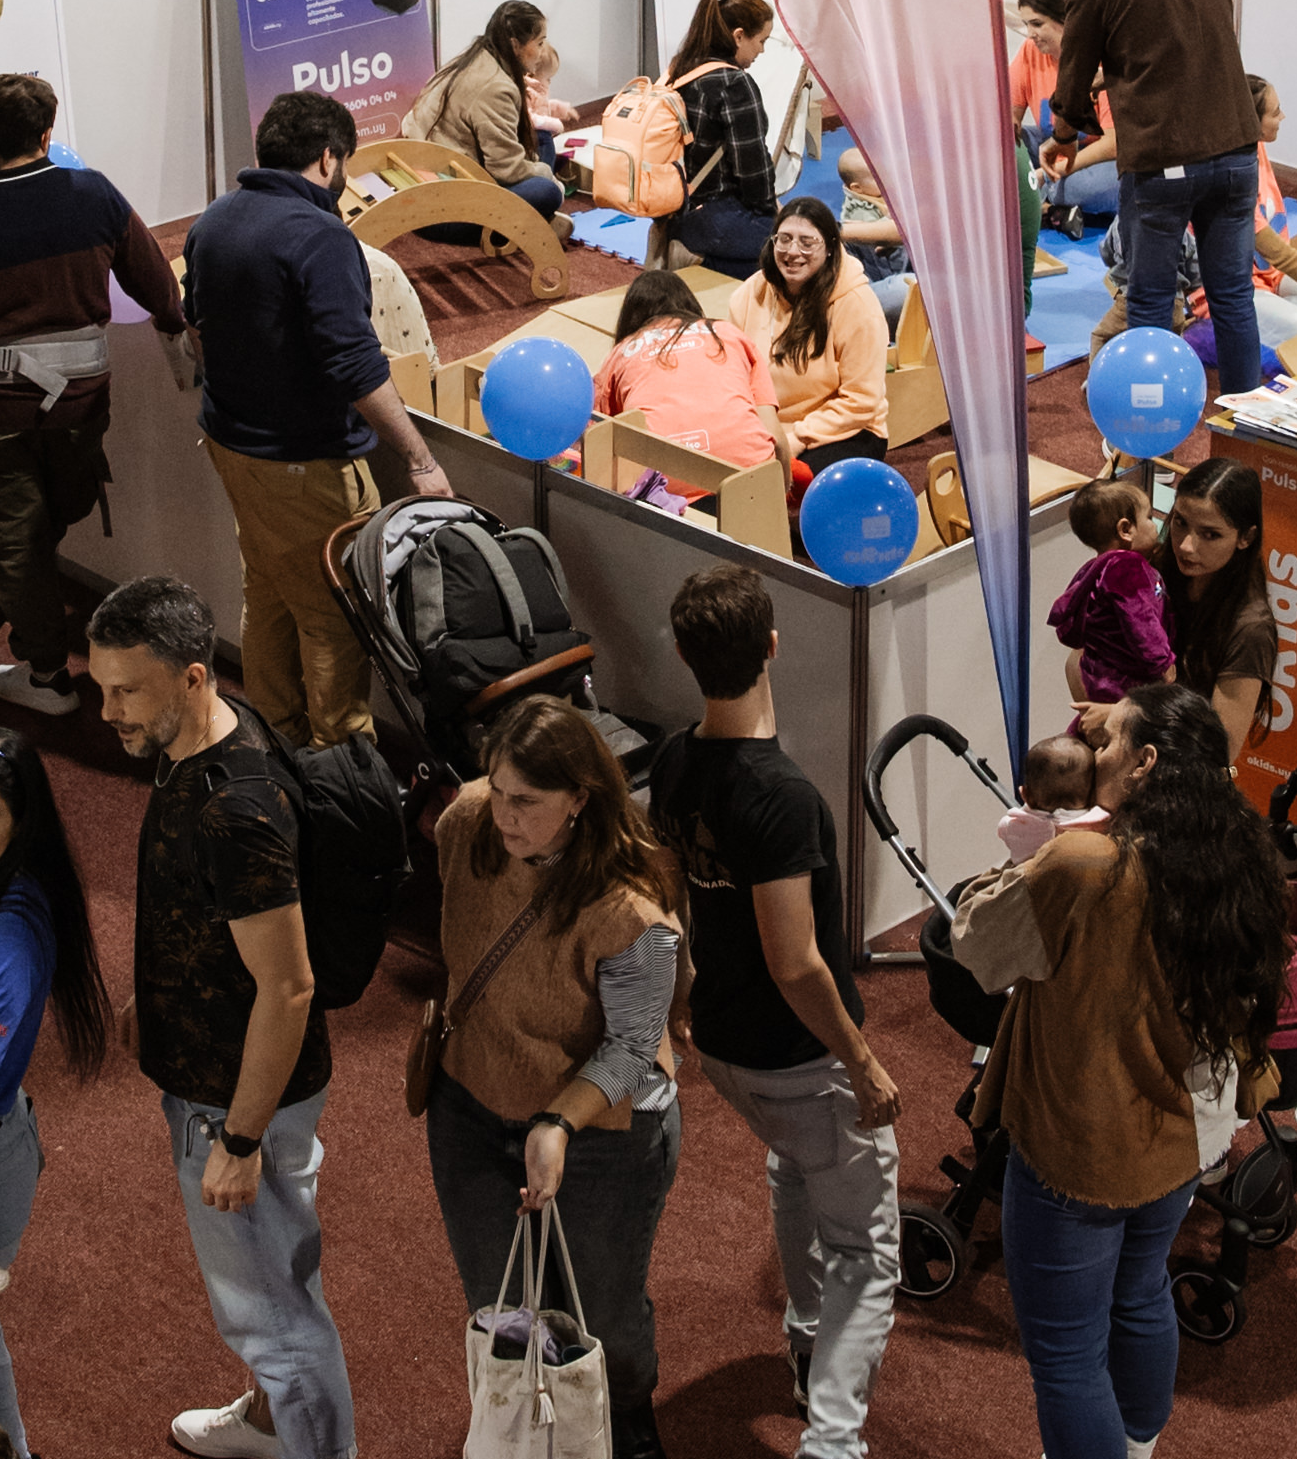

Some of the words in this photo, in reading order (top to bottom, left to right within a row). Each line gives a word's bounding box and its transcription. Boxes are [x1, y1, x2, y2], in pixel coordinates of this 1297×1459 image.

[293, 50, 393, 93] Pulso
[369, 94, 382, 106] 04
[384, 90, 397, 102] 04
[1246, 754, 1291, 779] okids.uy
